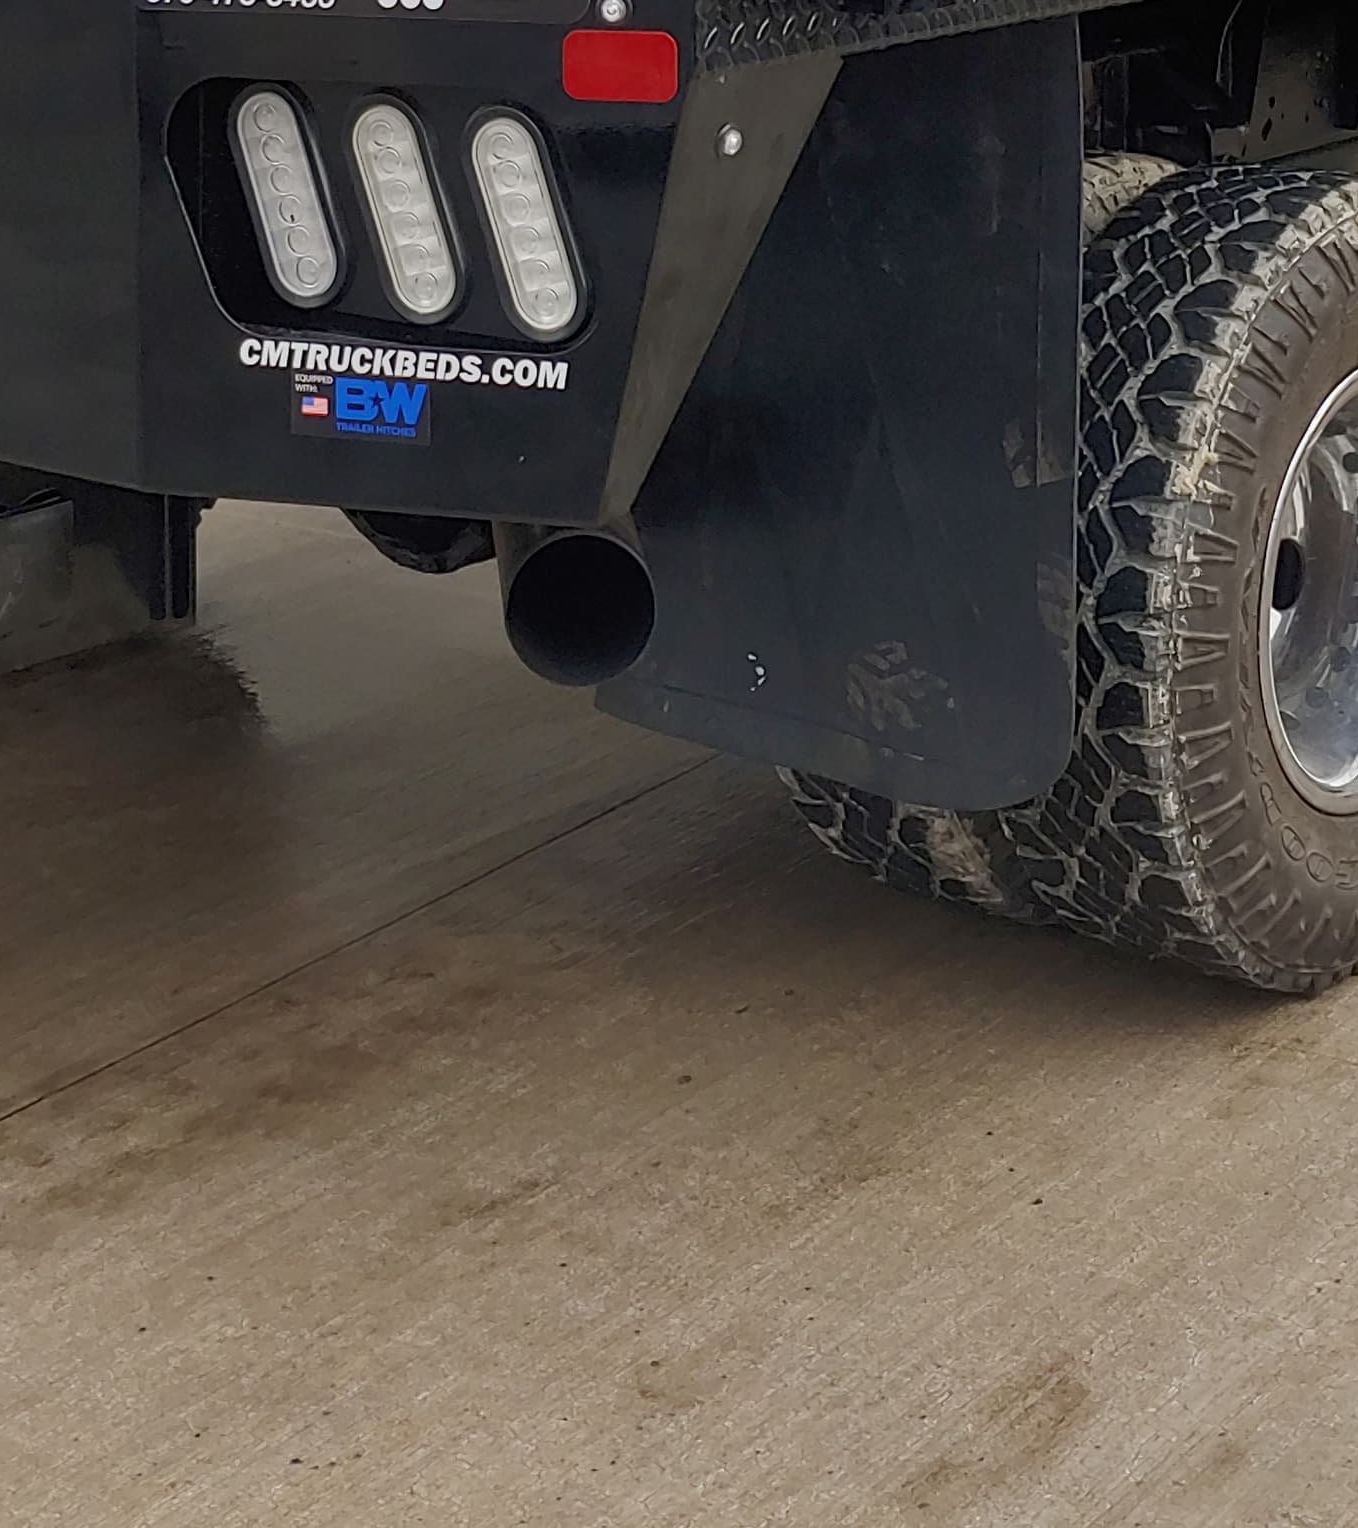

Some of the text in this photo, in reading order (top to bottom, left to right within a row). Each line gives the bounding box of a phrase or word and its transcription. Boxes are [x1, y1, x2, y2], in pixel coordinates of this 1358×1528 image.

[239, 337, 569, 390] CMTRUCKBEDS.COM
[294, 373, 334, 385] EQUIPPED
[336, 422, 417, 438] TRAILER HITCHES
